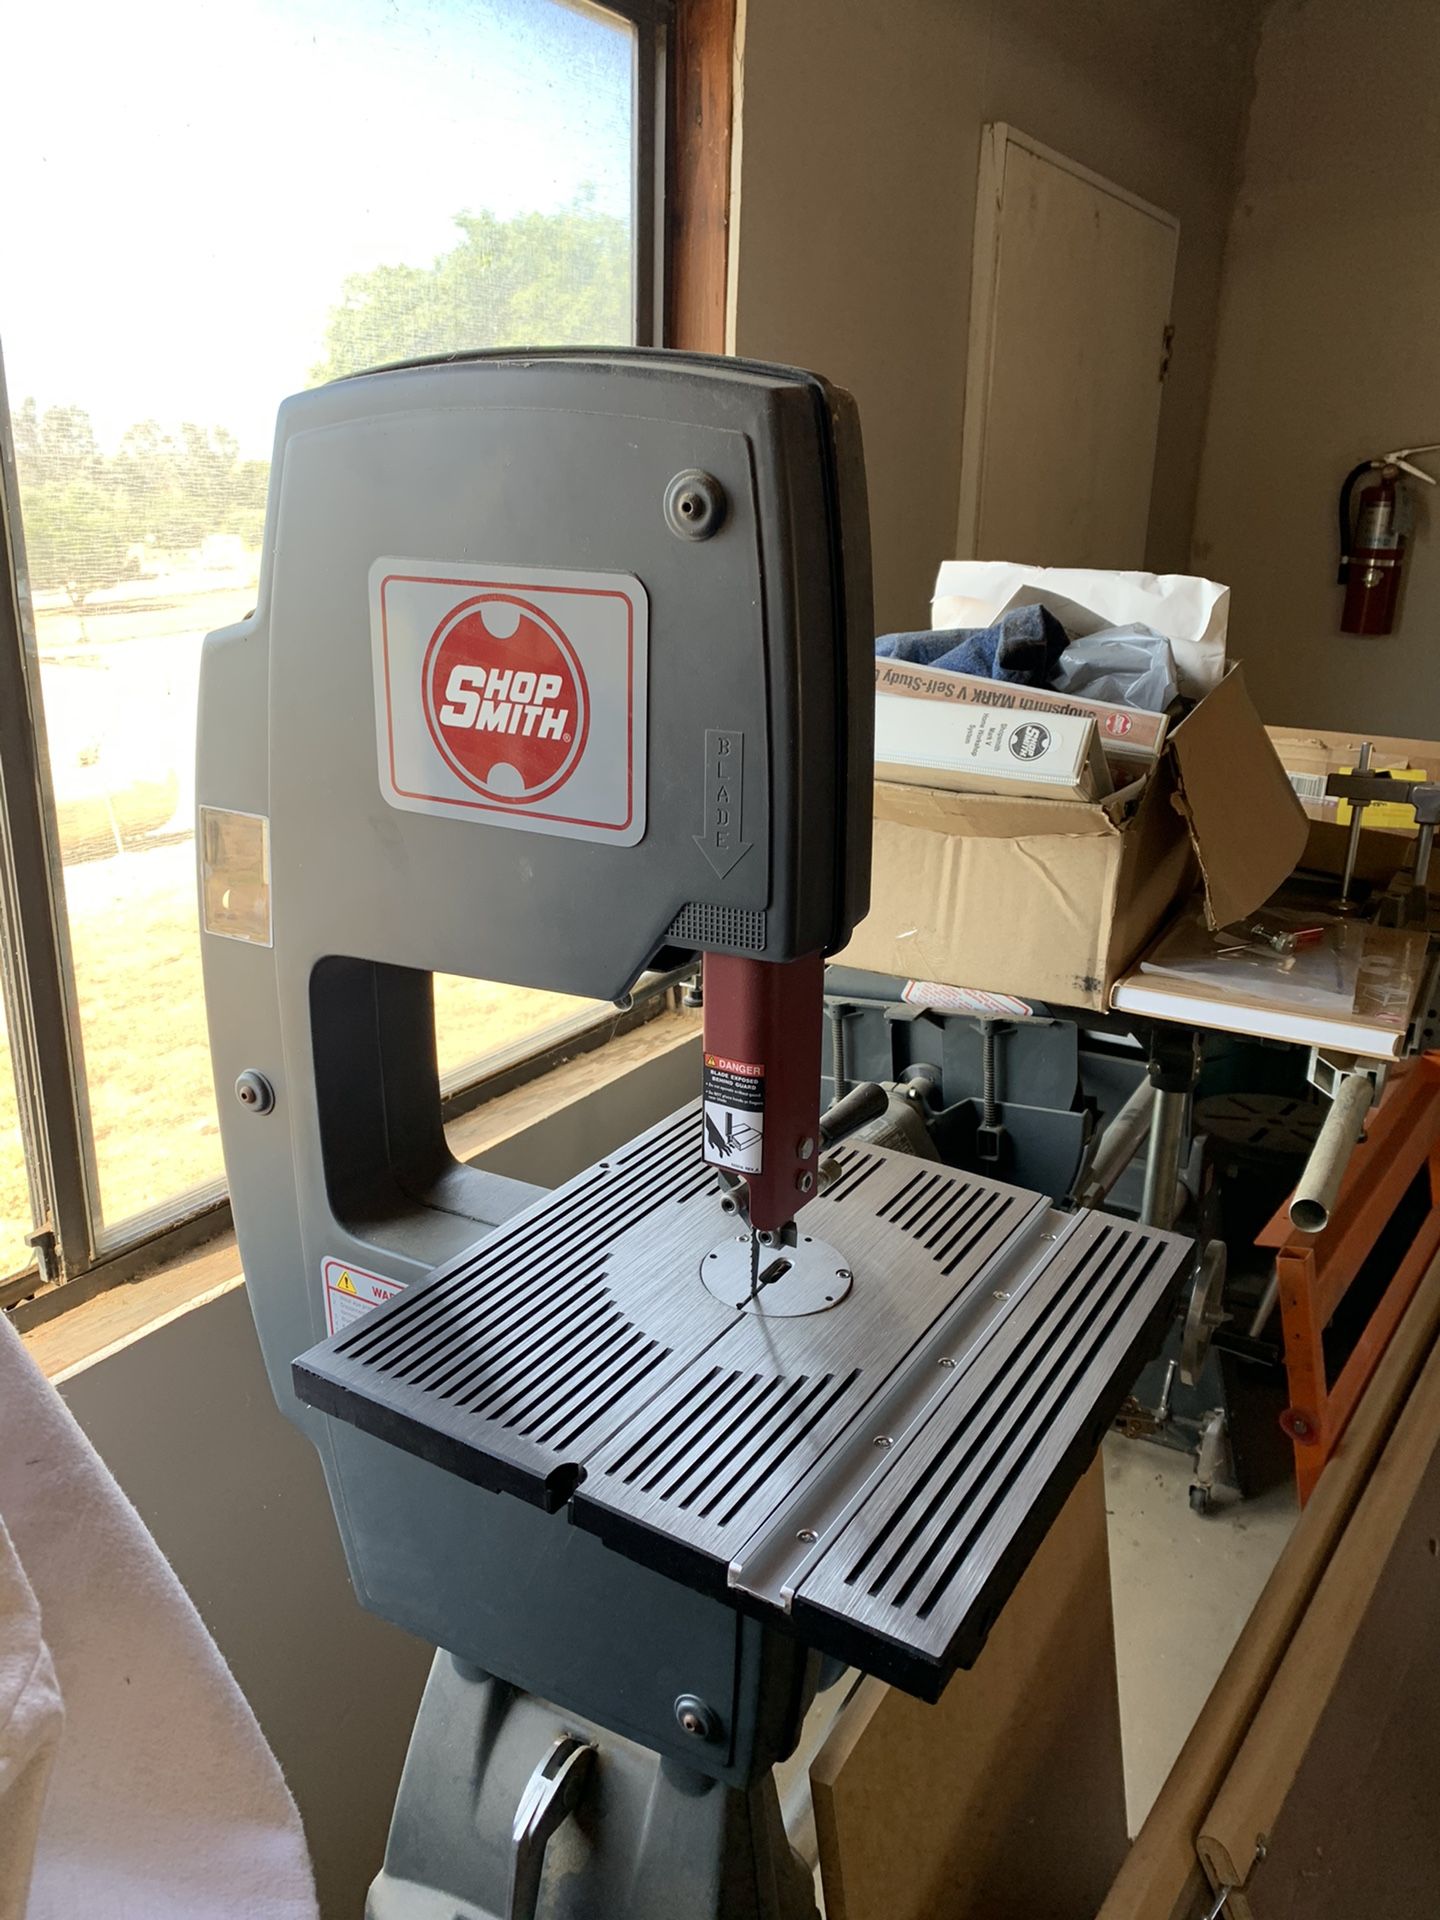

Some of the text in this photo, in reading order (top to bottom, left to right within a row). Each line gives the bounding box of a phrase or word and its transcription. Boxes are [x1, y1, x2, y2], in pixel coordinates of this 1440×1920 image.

[440, 664, 564, 715] SHOP
[883, 669, 955, 697] Self-Study
[957, 686, 967, 700] V
[971, 688, 1016, 709] MARK
[716, 737, 731, 849] BLADE
[710, 1069, 759, 1085] BLADE EXPOSED
[719, 1059, 761, 1076] DANGER
[735, 1081, 757, 1090] GUARD
